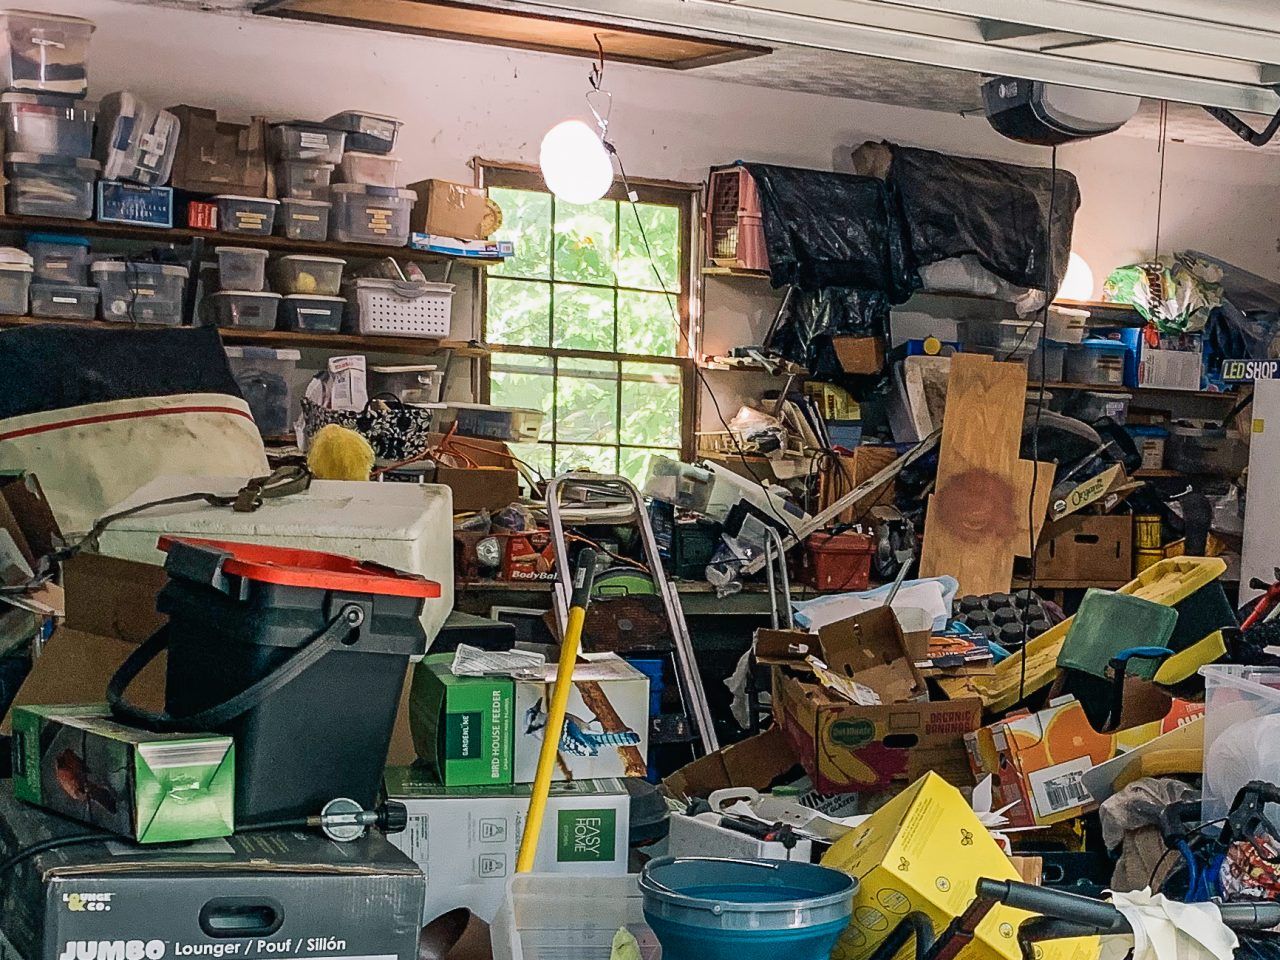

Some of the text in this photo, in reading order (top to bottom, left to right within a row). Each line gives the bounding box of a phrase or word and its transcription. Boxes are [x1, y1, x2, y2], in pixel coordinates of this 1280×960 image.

[1223, 361, 1245, 380] LED
[1245, 361, 1278, 380] SHOP
[511, 570, 559, 580] BodyBal
[491, 690, 501, 779] BIRD HOUSE FEEDER
[574, 817, 586, 853] HOME
[585, 817, 601, 855] EASY
[175, 942, 240, 958] Lounger
[257, 939, 293, 953] Pouf
[306, 937, 347, 951] Sillón
